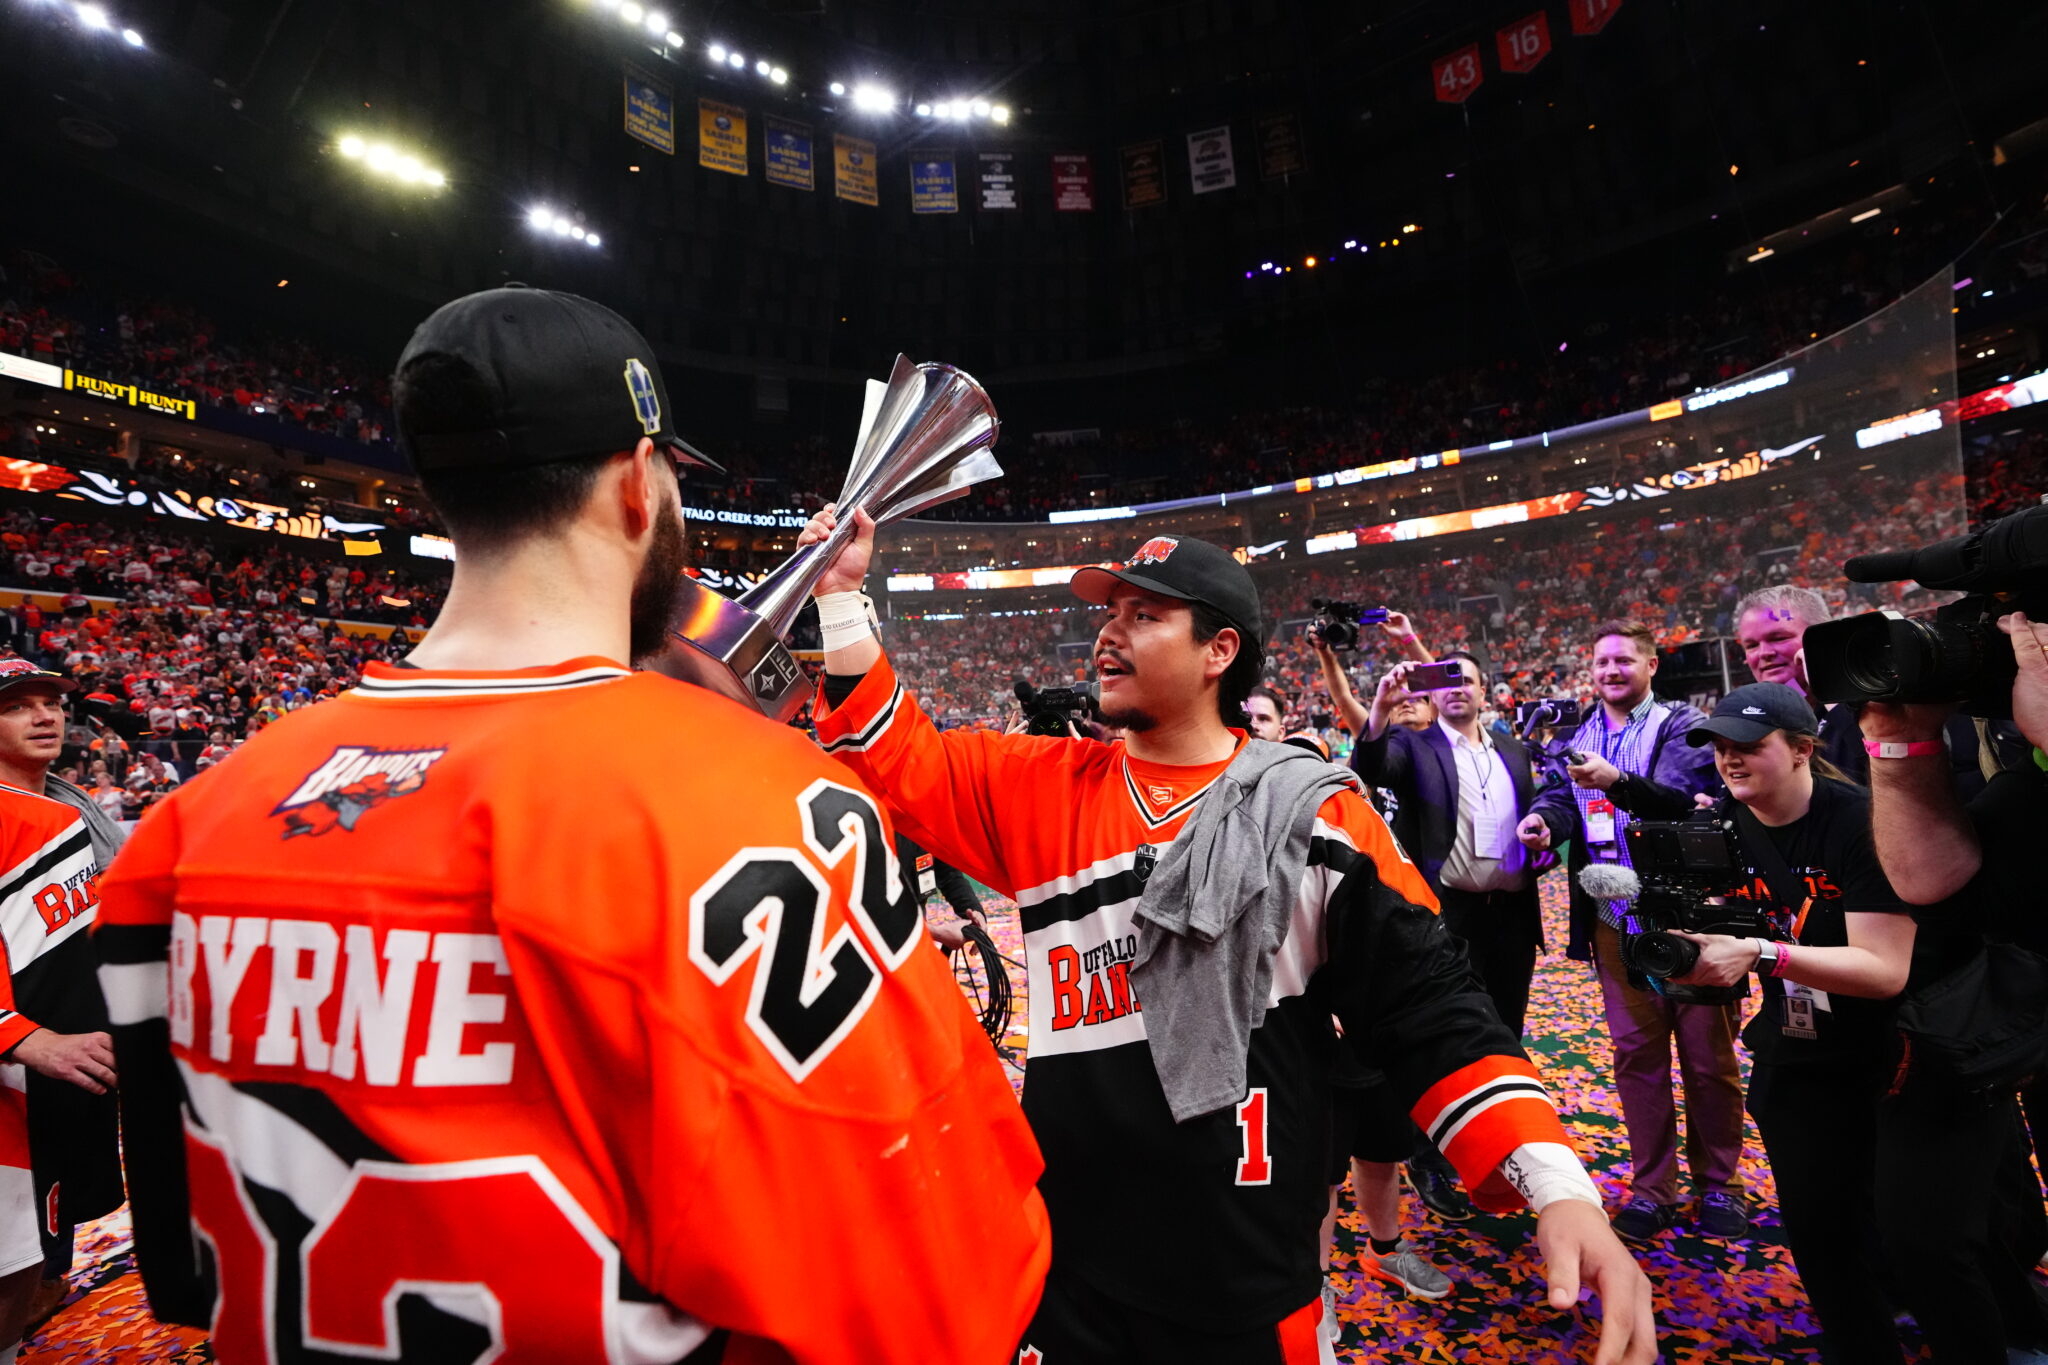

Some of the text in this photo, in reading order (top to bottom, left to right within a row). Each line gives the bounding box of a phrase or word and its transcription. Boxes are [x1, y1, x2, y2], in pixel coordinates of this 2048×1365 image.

[1507, 24, 1541, 61] 16
[1439, 54, 1477, 91] 43
[704, 128, 743, 144] SABRES
[76, 374, 128, 397] HUNT
[139, 390, 185, 412] HUNT
[717, 511, 752, 525] CREEK
[753, 515, 777, 526] 300
[771, 648, 794, 680] NLL
[1137, 846, 1157, 857] NLL
[688, 778, 923, 1083] 22
[169, 911, 516, 1088] BYRNE
[1048, 944, 1143, 1032] BAN
[1235, 1087, 1272, 1187] 1
